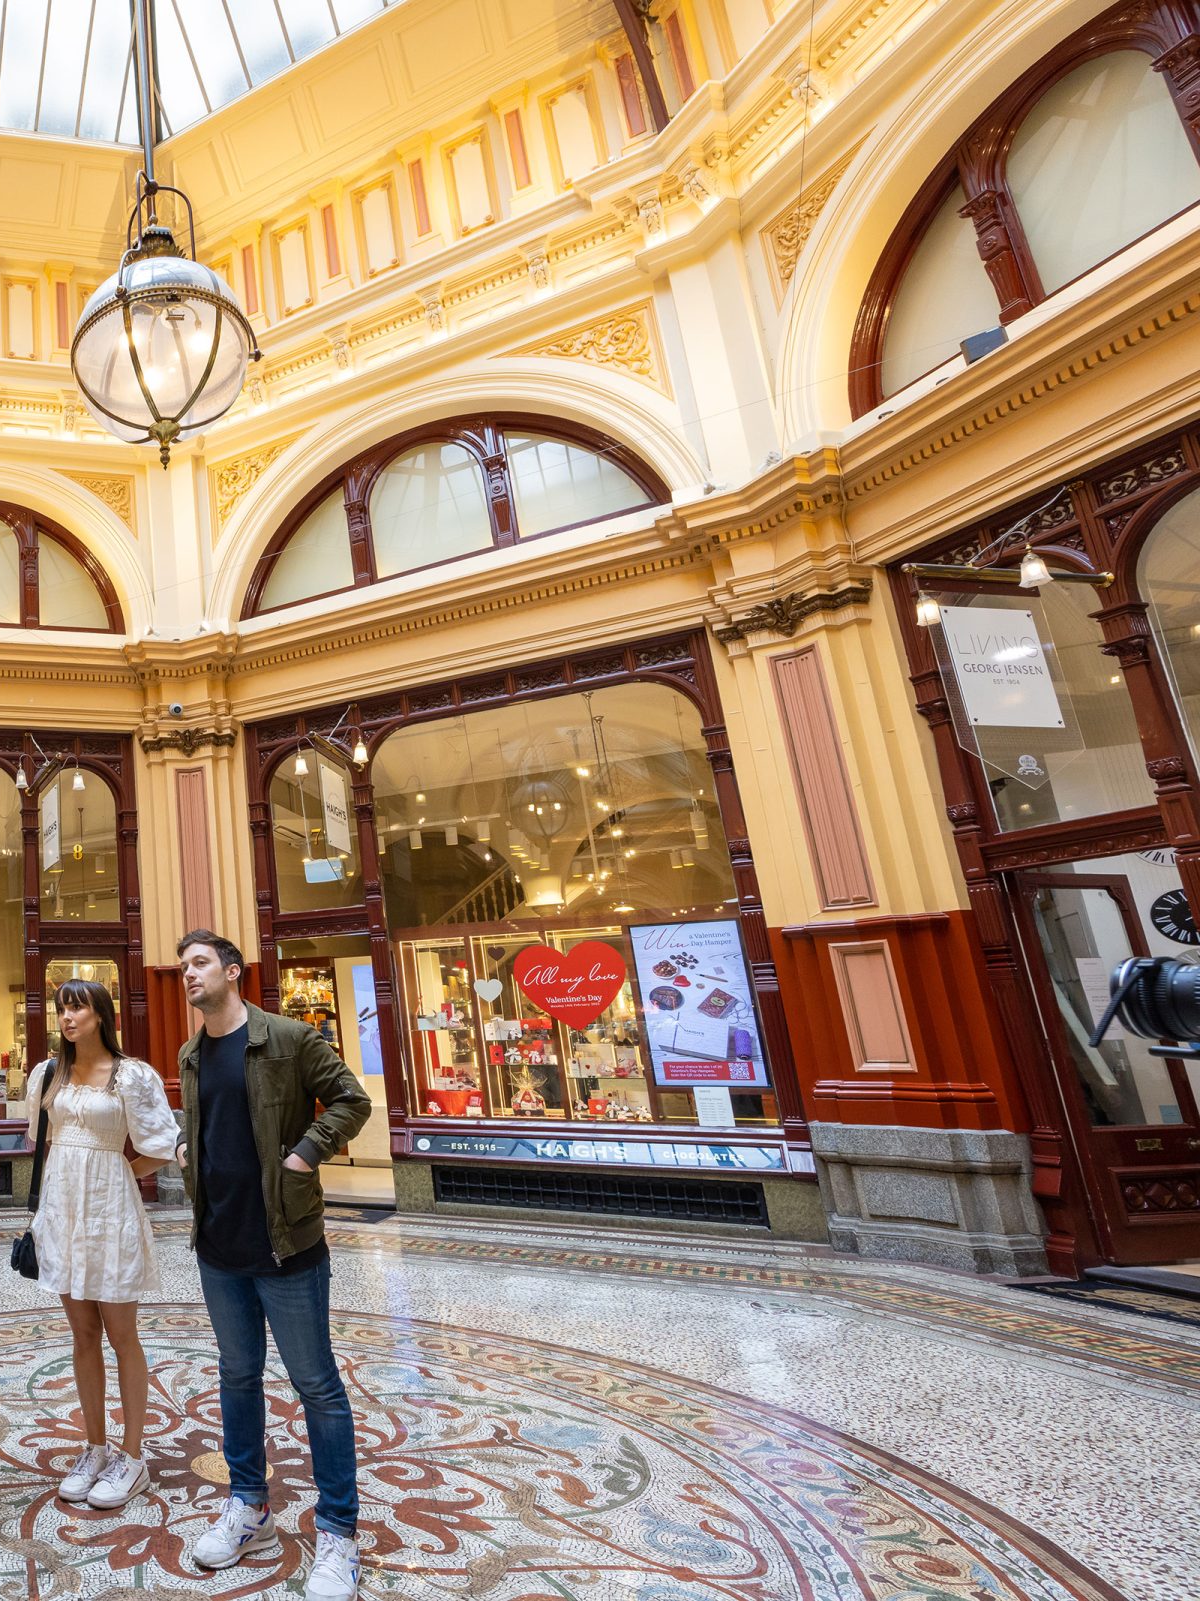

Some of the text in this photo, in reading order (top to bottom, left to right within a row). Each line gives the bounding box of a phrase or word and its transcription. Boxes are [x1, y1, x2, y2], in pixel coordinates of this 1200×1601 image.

[953, 633, 1039, 658] LIVING
[963, 663, 1043, 675] GEORG JENSEN
[325, 801, 347, 820] HAIGH'S
[311, 828, 321, 845] 7
[73, 844, 83, 860] 8
[631, 923, 689, 951] Win
[694, 931, 731, 939] Valentine's
[704, 938, 732, 946] Hamper
[523, 962, 619, 993] All my love
[545, 994, 603, 1004] Valentine's Day
[450, 1142, 745, 1162] EST. 1915 HAIGH'S CHOCOLATES
